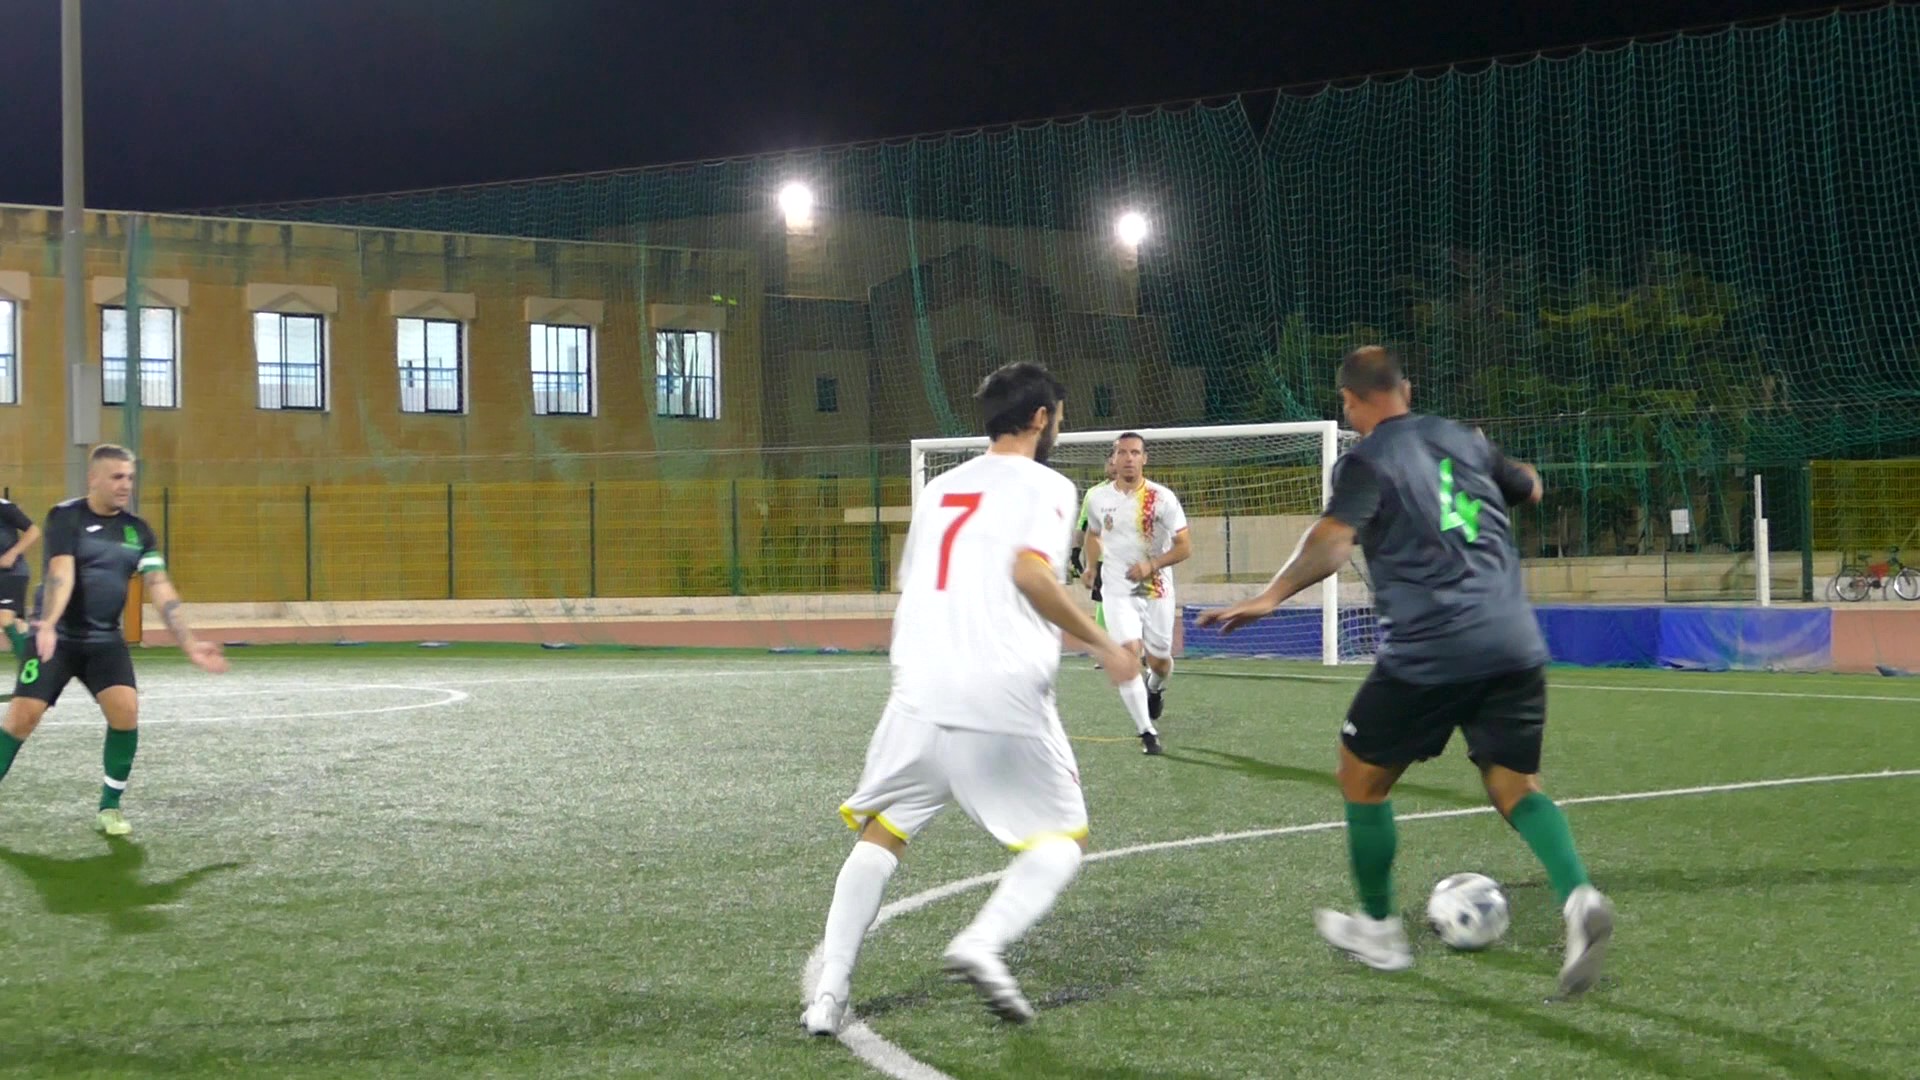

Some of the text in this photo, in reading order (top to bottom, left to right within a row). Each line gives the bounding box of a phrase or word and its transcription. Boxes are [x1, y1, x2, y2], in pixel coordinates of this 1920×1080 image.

[936, 492, 983, 590] 7
[1440, 457, 1482, 543] 4
[21, 658, 39, 684] 8
